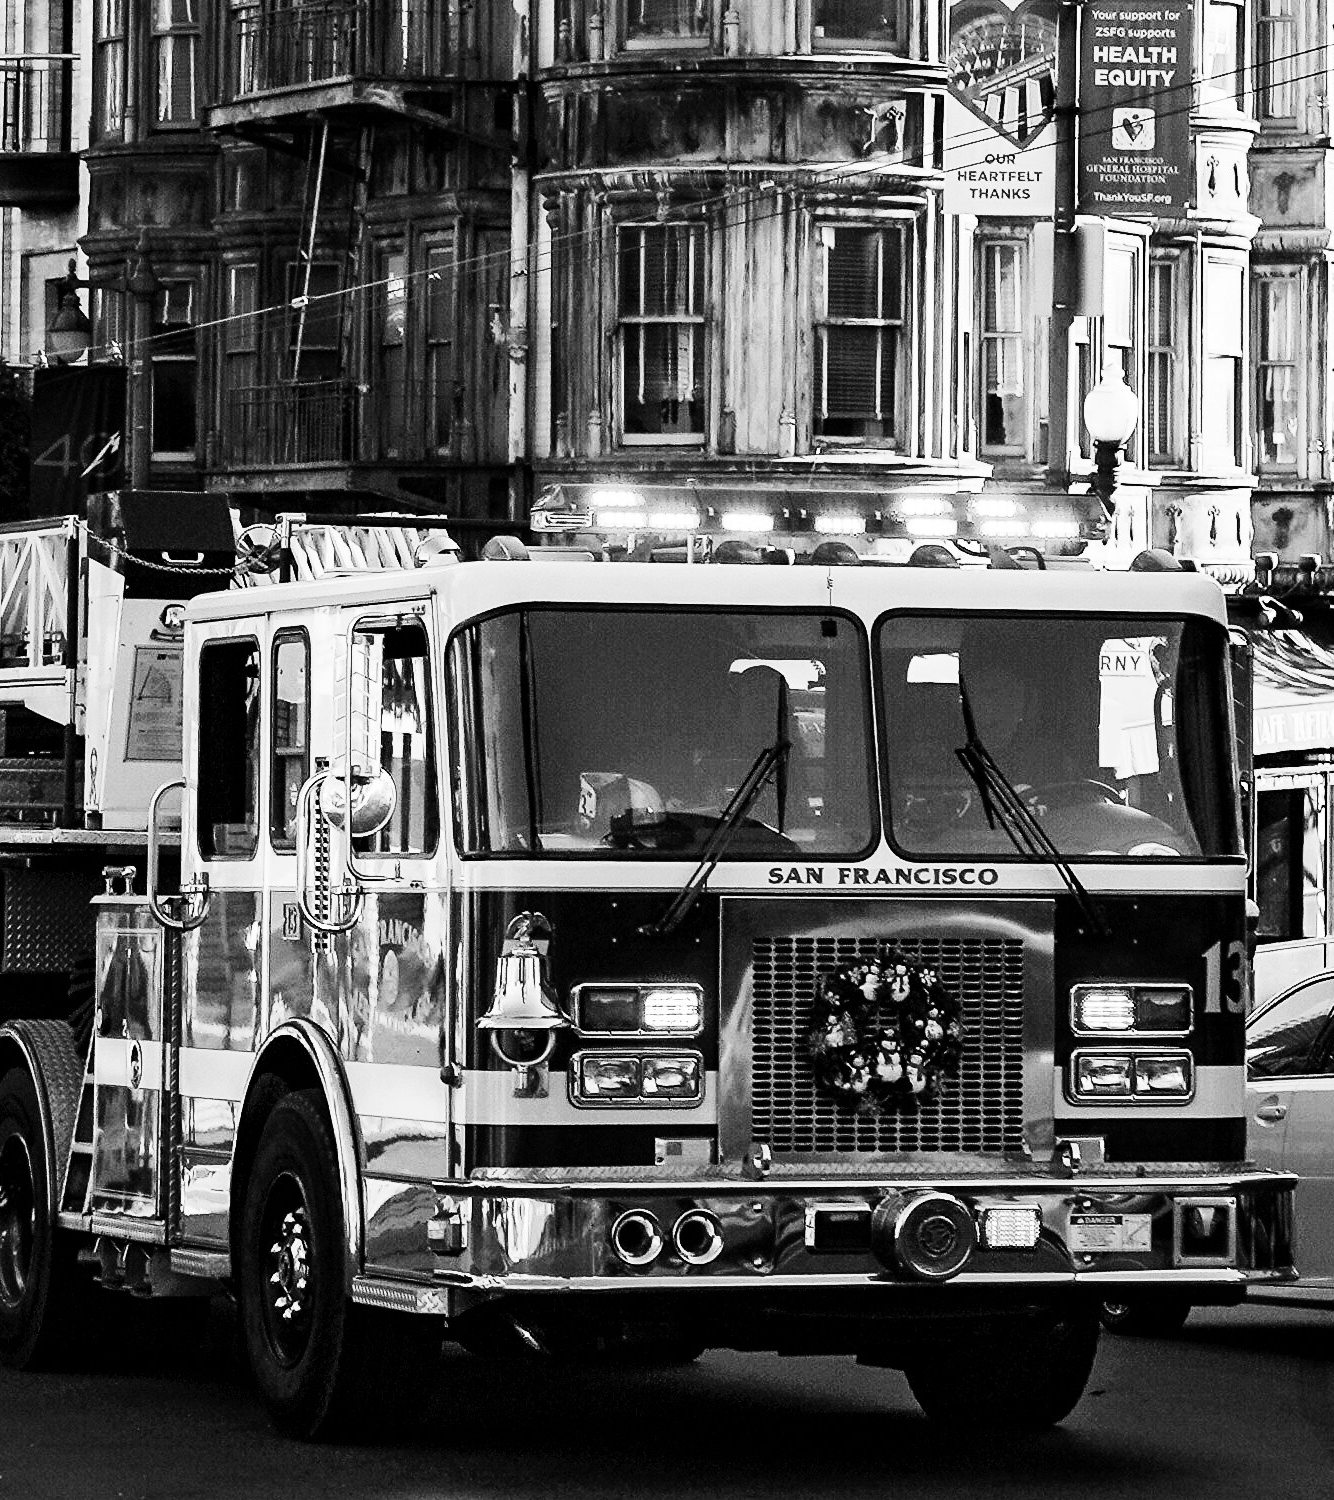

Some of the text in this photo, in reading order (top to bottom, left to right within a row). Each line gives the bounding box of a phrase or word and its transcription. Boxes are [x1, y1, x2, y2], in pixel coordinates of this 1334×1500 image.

[1092, 10, 1180, 24] Your support for
[1127, 28, 1176, 39] supports
[1093, 46, 1177, 64] HEALTH
[1094, 69, 1175, 87] EQUITY
[984, 153, 1016, 164] OUR
[1086, 165, 1179, 174] GENERAL HOSPITAL
[957, 170, 1043, 182] HEARTFELT
[1099, 174, 1166, 183] FOUNDATION
[969, 188, 1031, 199] THANKS
[768, 867, 998, 885] SAN FRANCISCO
[1201, 940, 1251, 1014] 13
